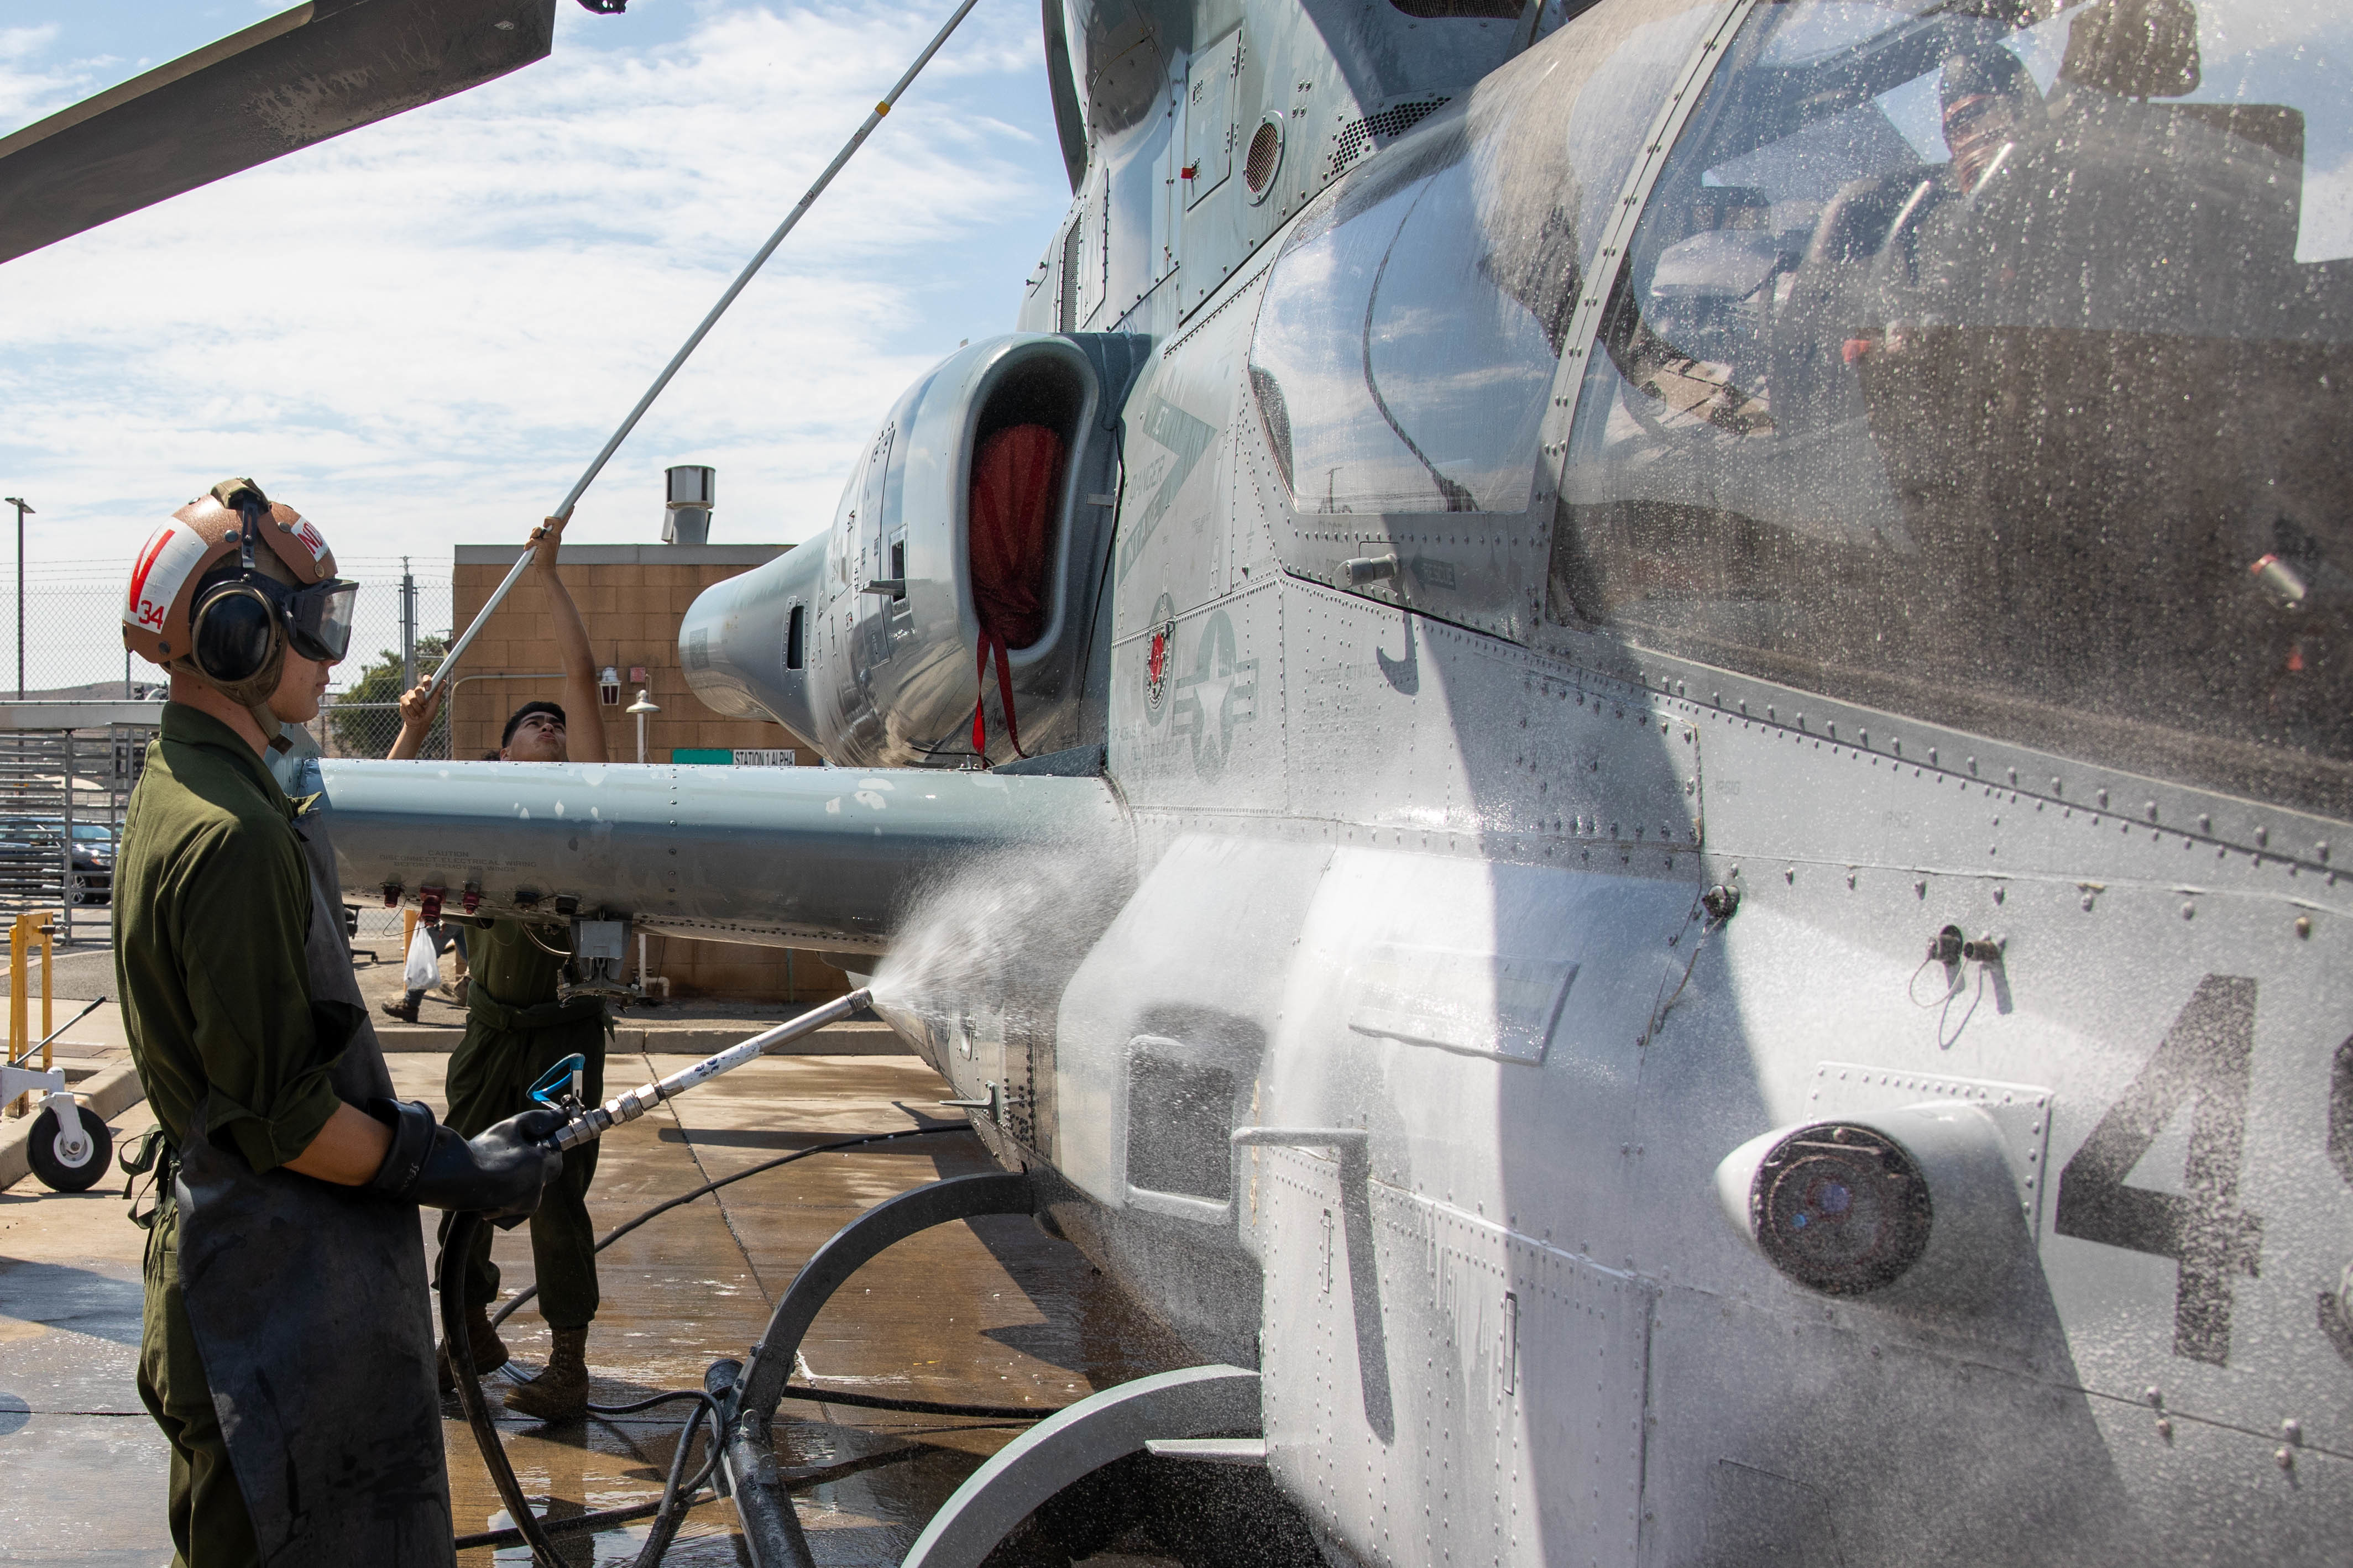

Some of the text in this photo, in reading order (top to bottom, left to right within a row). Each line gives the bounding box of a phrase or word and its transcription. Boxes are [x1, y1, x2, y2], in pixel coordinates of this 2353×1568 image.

[1130, 454, 1165, 500] DANGER
[1126, 493, 1160, 570] INTAKE
[138, 599, 164, 630] 34
[735, 751, 764, 765] STATION
[772, 751, 793, 766] ALPHA
[379, 854, 437, 863] DISCONNECT
[441, 857, 500, 866] ELECTRICAL
[427, 849, 469, 858] CAUTION
[435, 863, 483, 871] REMOVING
[2054, 973, 2353, 1368] 4
